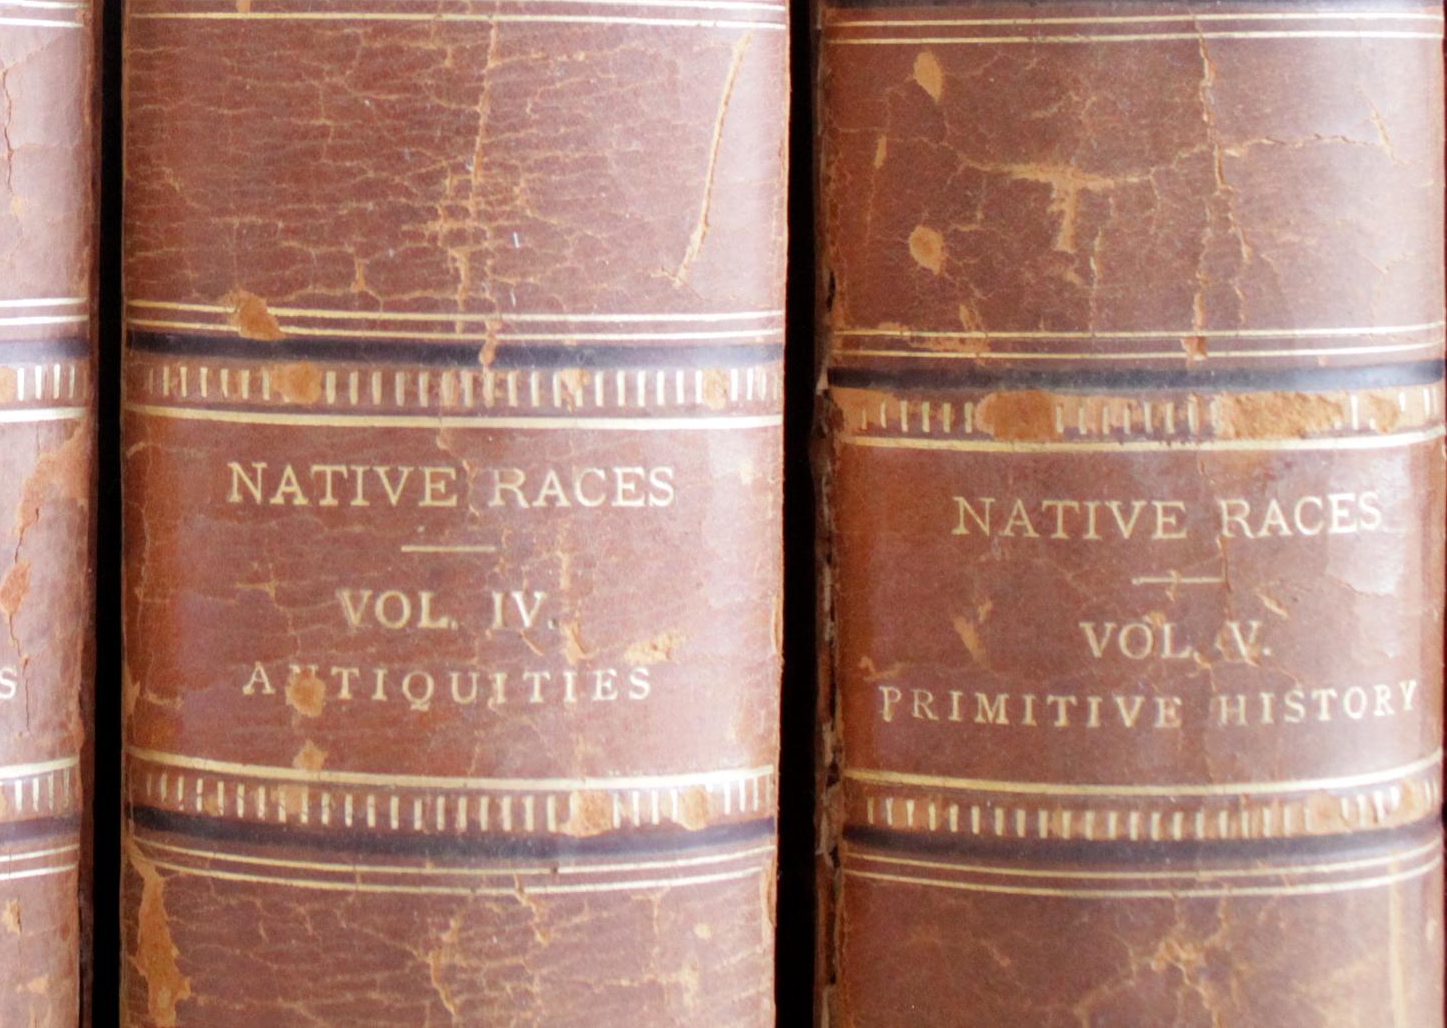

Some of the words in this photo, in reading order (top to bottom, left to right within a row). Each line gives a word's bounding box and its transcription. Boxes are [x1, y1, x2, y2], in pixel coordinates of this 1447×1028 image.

[227, 461, 458, 508] NATIVE
[488, 466, 676, 509] RACES
[952, 496, 1187, 540] NATIVE
[1218, 491, 1383, 539] RACES
[336, 589, 458, 630] VOL.
[491, 590, 555, 631] IV.
[1079, 620, 1200, 661] VOL.
[1221, 620, 1271, 662] V.
[878, 685, 1183, 729] PRIMITIVE
[1218, 679, 1418, 727] HISTORY
